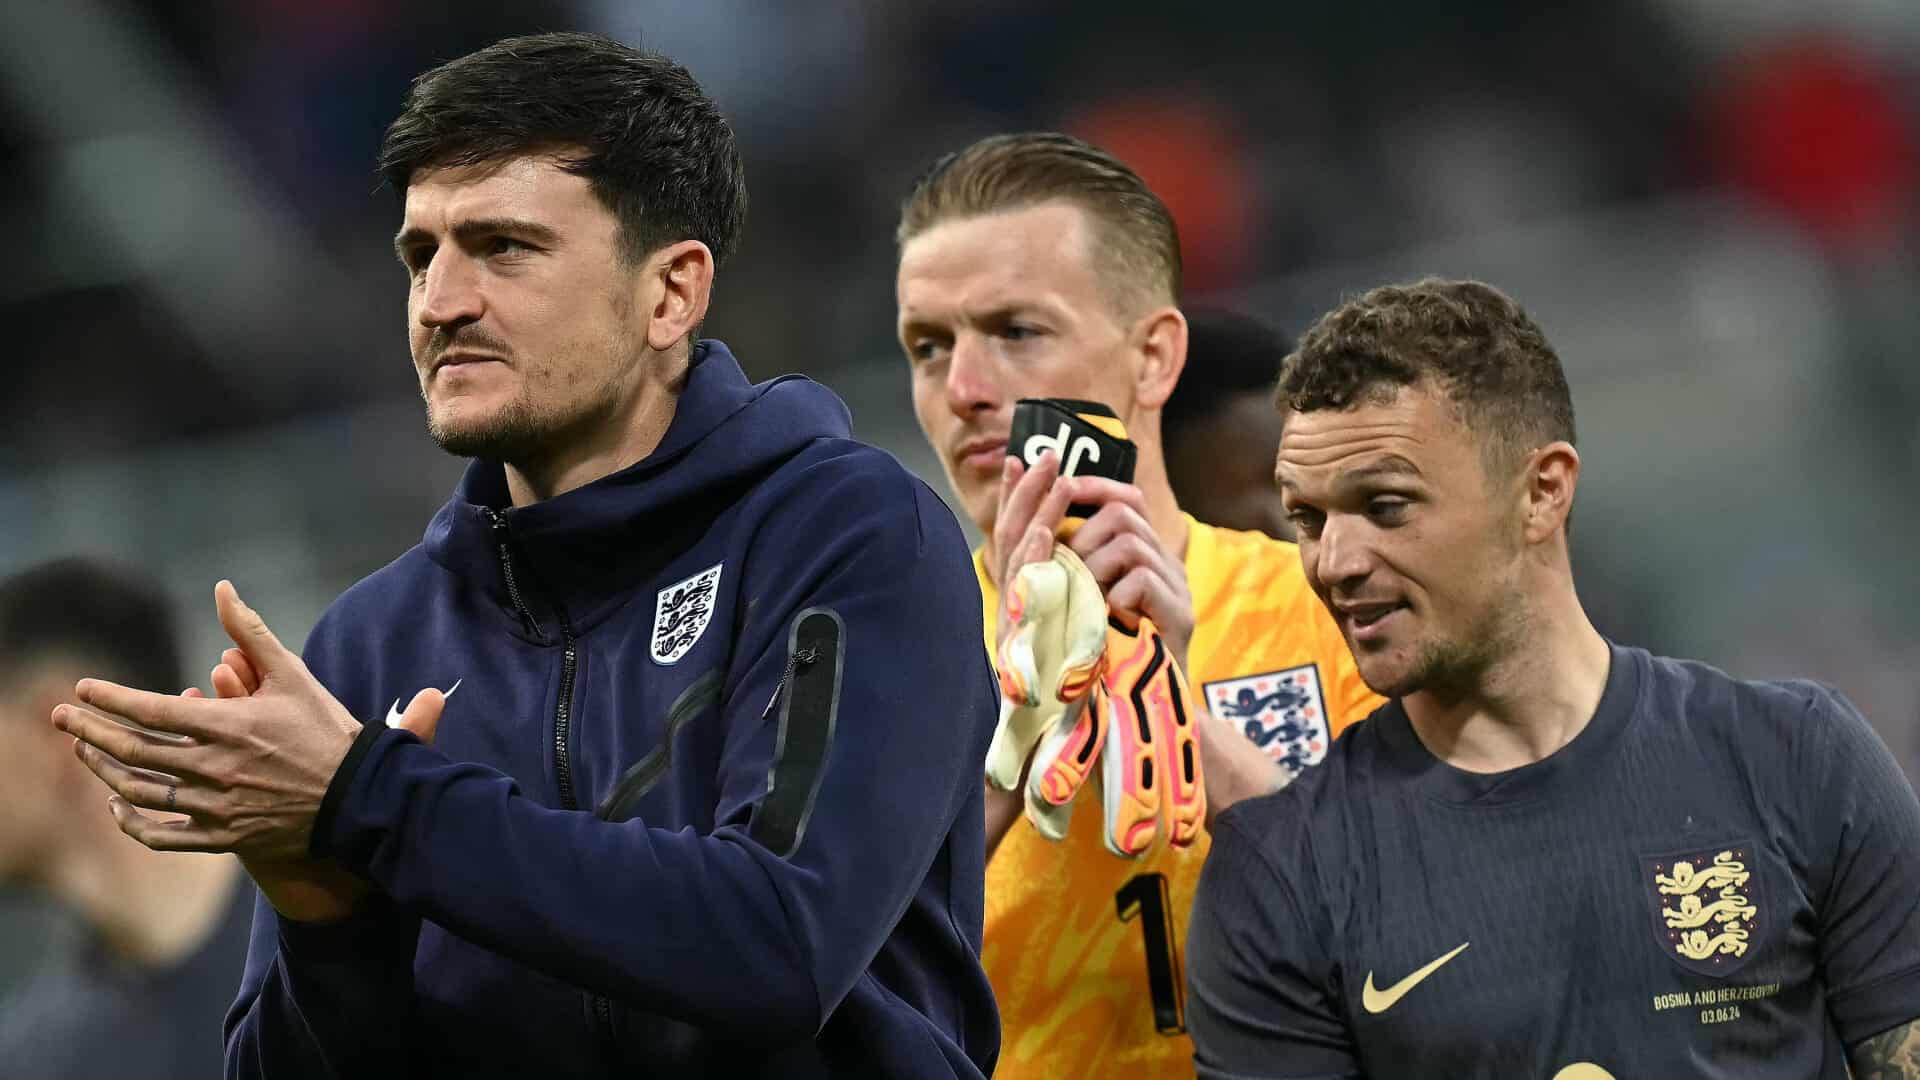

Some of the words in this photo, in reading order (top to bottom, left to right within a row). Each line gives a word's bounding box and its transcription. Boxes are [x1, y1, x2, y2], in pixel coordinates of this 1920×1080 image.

[1115, 872, 1186, 1036] 1
[1653, 992, 1692, 1011] BOSNIA
[1694, 990, 1716, 1006] AND
[1700, 1005, 1741, 1025] 03.06.24
